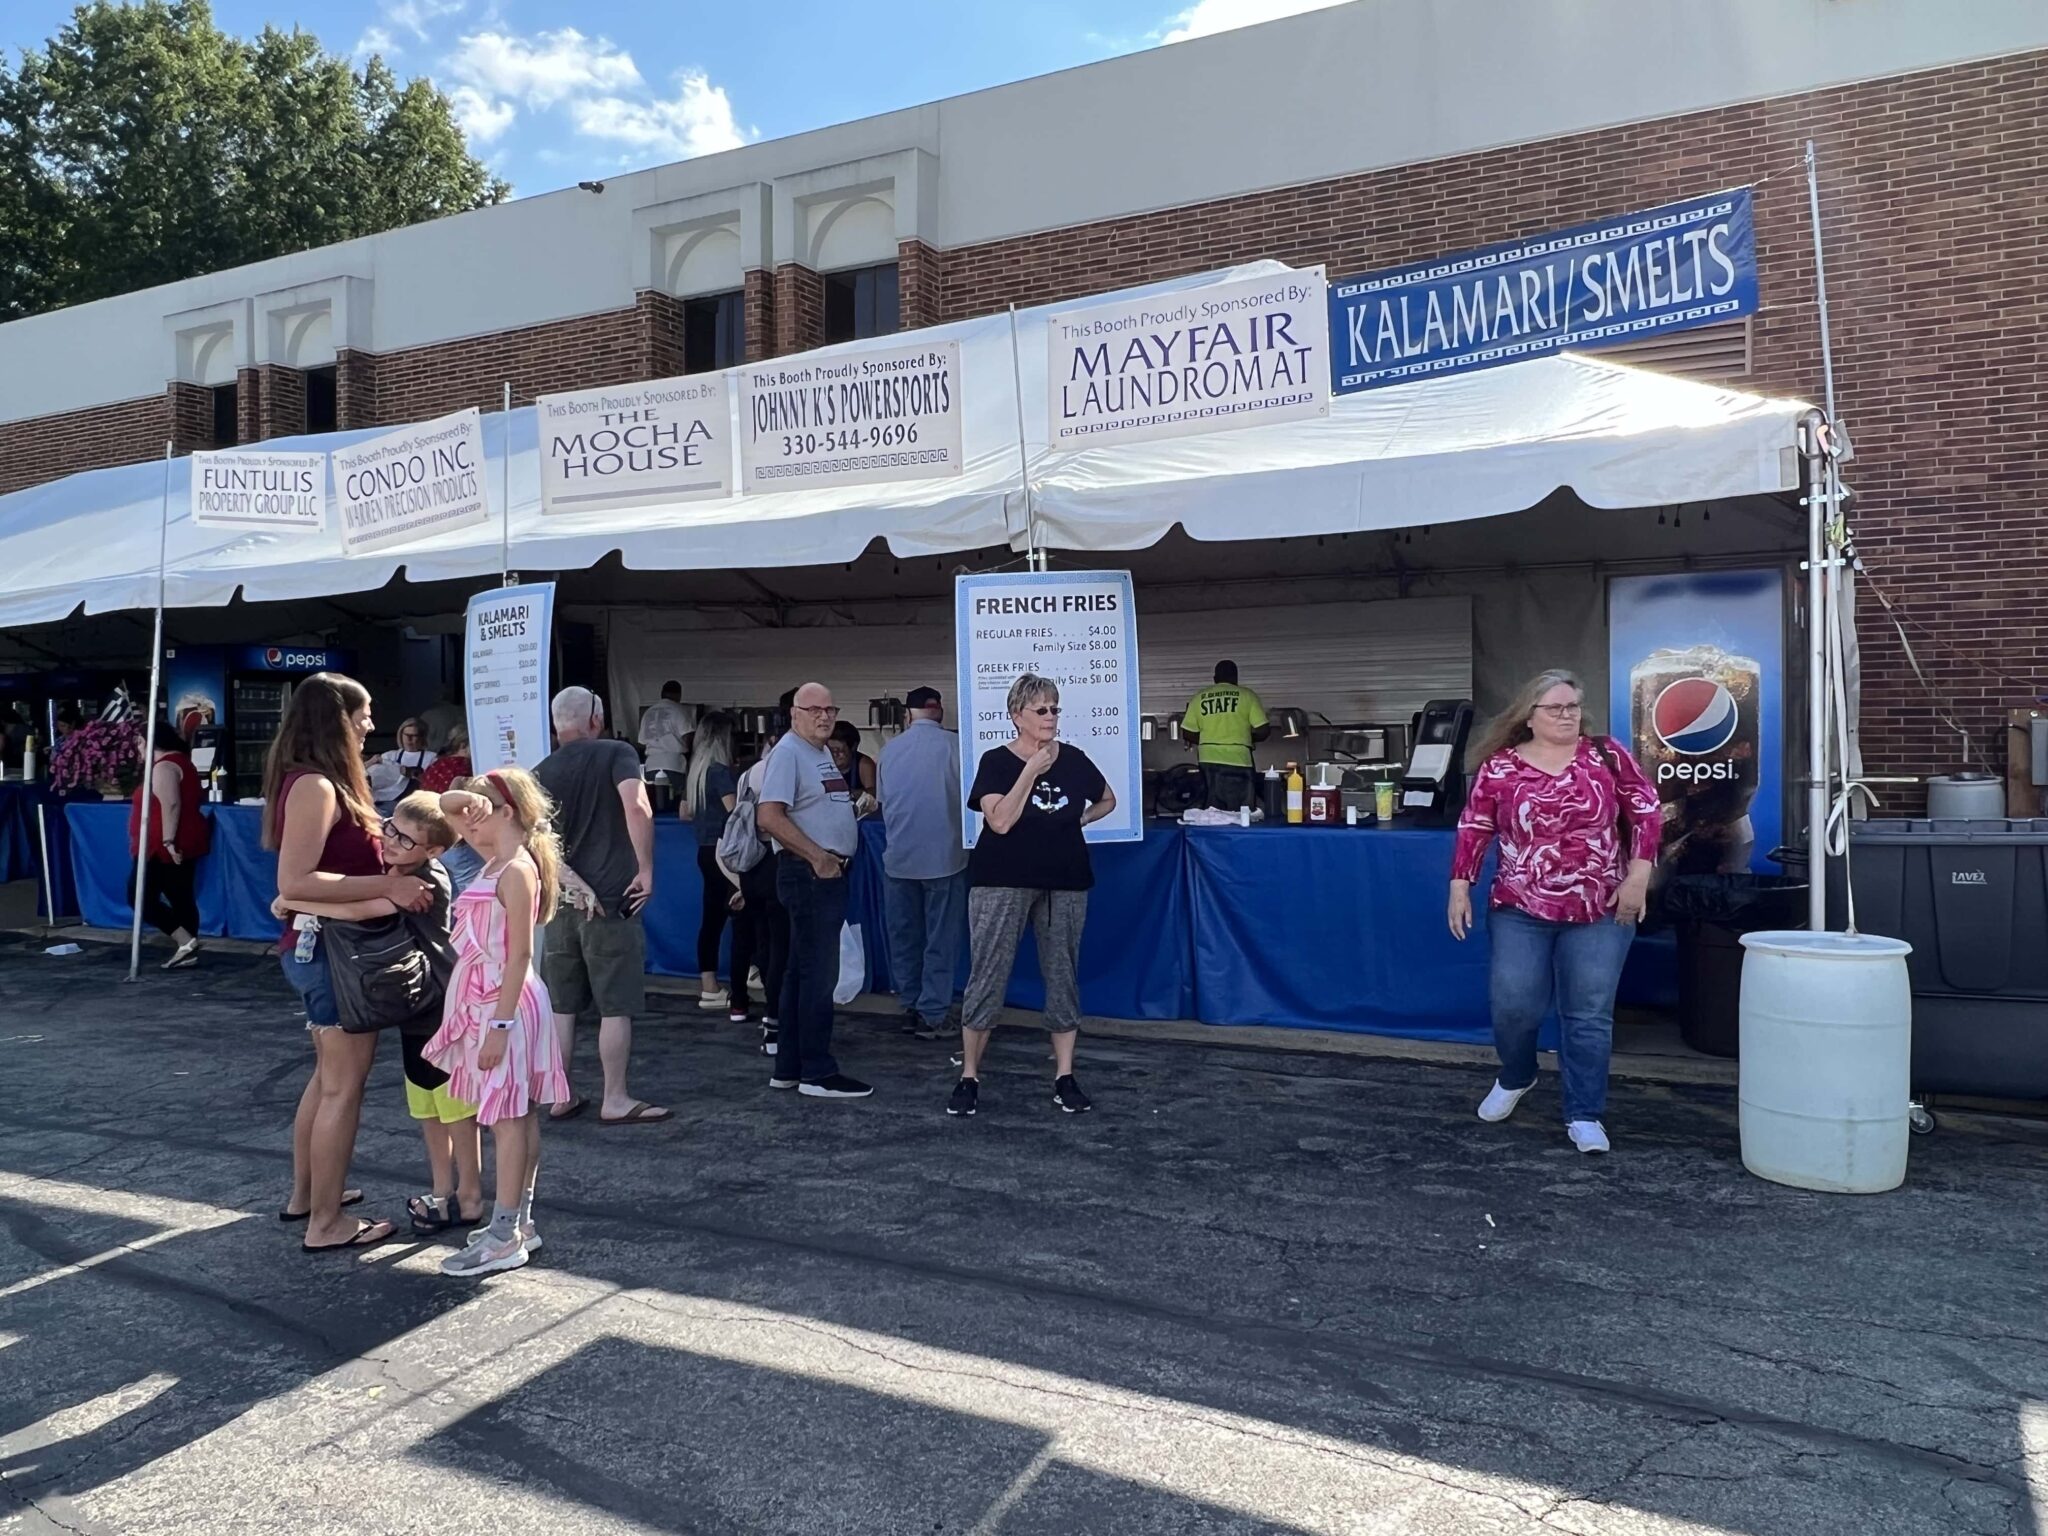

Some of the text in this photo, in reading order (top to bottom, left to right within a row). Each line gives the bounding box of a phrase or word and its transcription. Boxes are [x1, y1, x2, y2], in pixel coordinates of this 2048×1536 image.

[1062, 285, 1312, 340] This Booth Proudly Sponsored By:
[1071, 312, 1299, 381] MAYFAIR
[753, 352, 947, 388] This Booth Proudly Sponsored By:
[1063, 346, 1312, 418] LAUNDROMAT
[599, 409, 660, 426] THE
[752, 370, 950, 445] JOHNNY K'S POWERSPORTS
[340, 459, 356, 470] This
[357, 451, 381, 466] Booth
[382, 441, 413, 459] Proudly
[414, 424, 459, 449] Sponsored
[552, 420, 713, 457] MOCHA
[783, 422, 918, 456] 330-544-9696
[346, 441, 475, 501] CONDO INC.
[563, 444, 703, 479] HOUSE
[204, 469, 313, 493] FUNTULIS
[200, 492, 317, 516] PROPERTY GROUP LLC
[345, 471, 477, 529] WARREN PRECISION PRODUCTS
[478, 605, 529, 626] KALAMARI
[976, 594, 1117, 615] FRENCH FRIES
[480, 621, 525, 641] & SMELTS
[976, 625, 1116, 639] REGULAR FRIES $4.00
[1033, 640, 1117, 653] Family Size $8.00
[286, 652, 326, 668] pepsi
[977, 659, 1117, 674] GREEK FRIES $6.00
[1069, 675, 1088, 685] Size
[978, 711, 1003, 722] SOFT
[1091, 706, 1119, 718] $3.00
[1201, 697, 1239, 716] STAFF
[979, 730, 1017, 741] BOTTLE
[1657, 758, 1733, 784] pepsi
[1952, 869, 1987, 884] LAVEX
